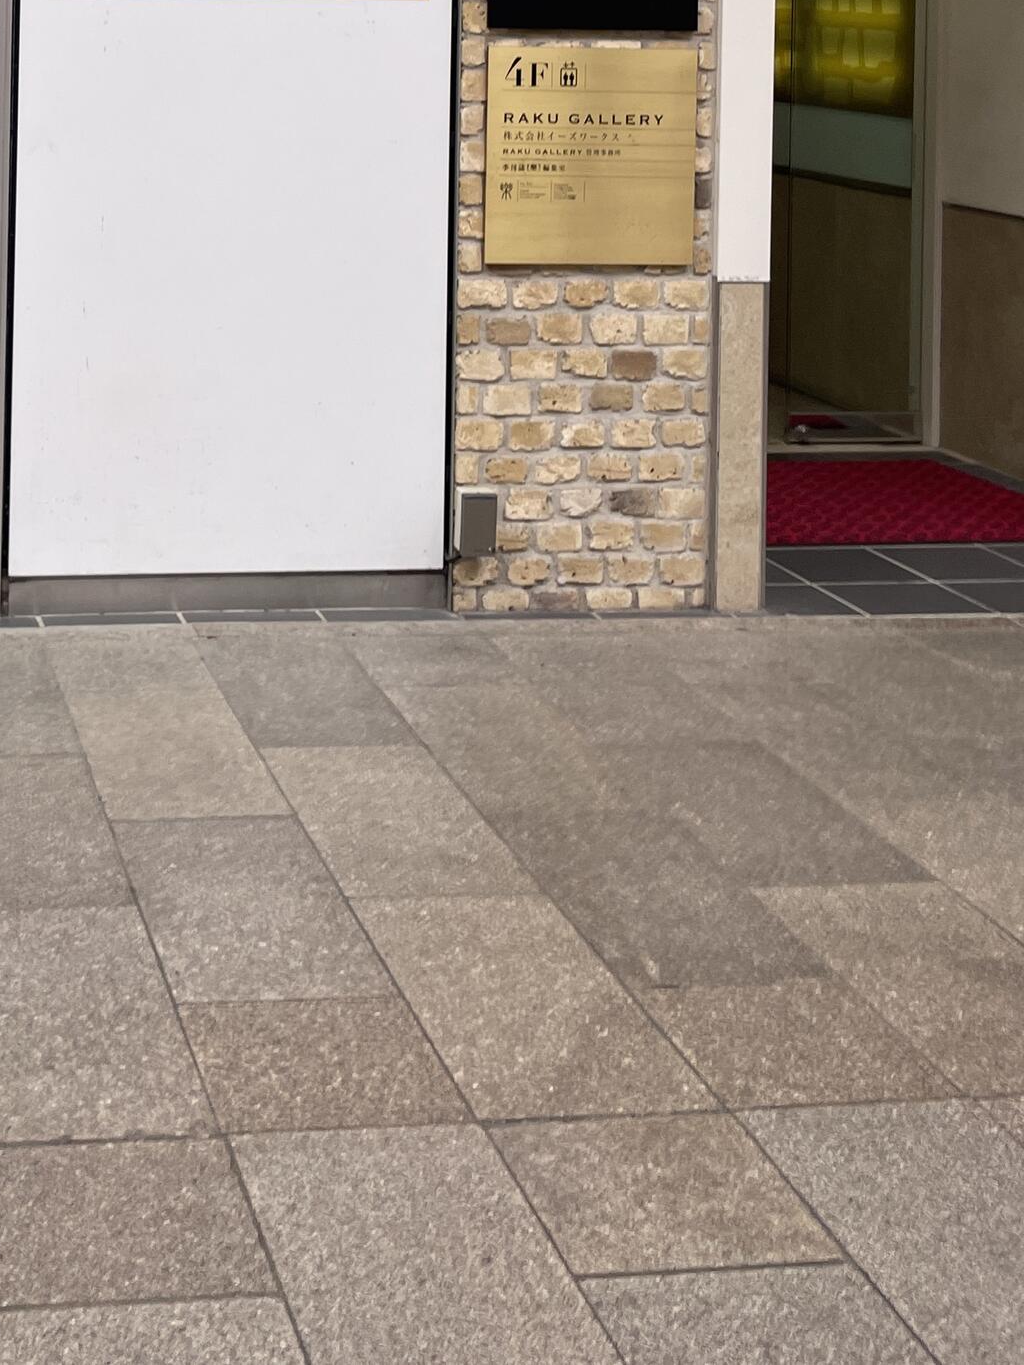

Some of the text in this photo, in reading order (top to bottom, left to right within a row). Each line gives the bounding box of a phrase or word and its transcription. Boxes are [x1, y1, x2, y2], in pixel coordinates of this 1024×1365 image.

[504, 56, 549, 87] 4F
[503, 112, 664, 126] RAKU GALLERY
